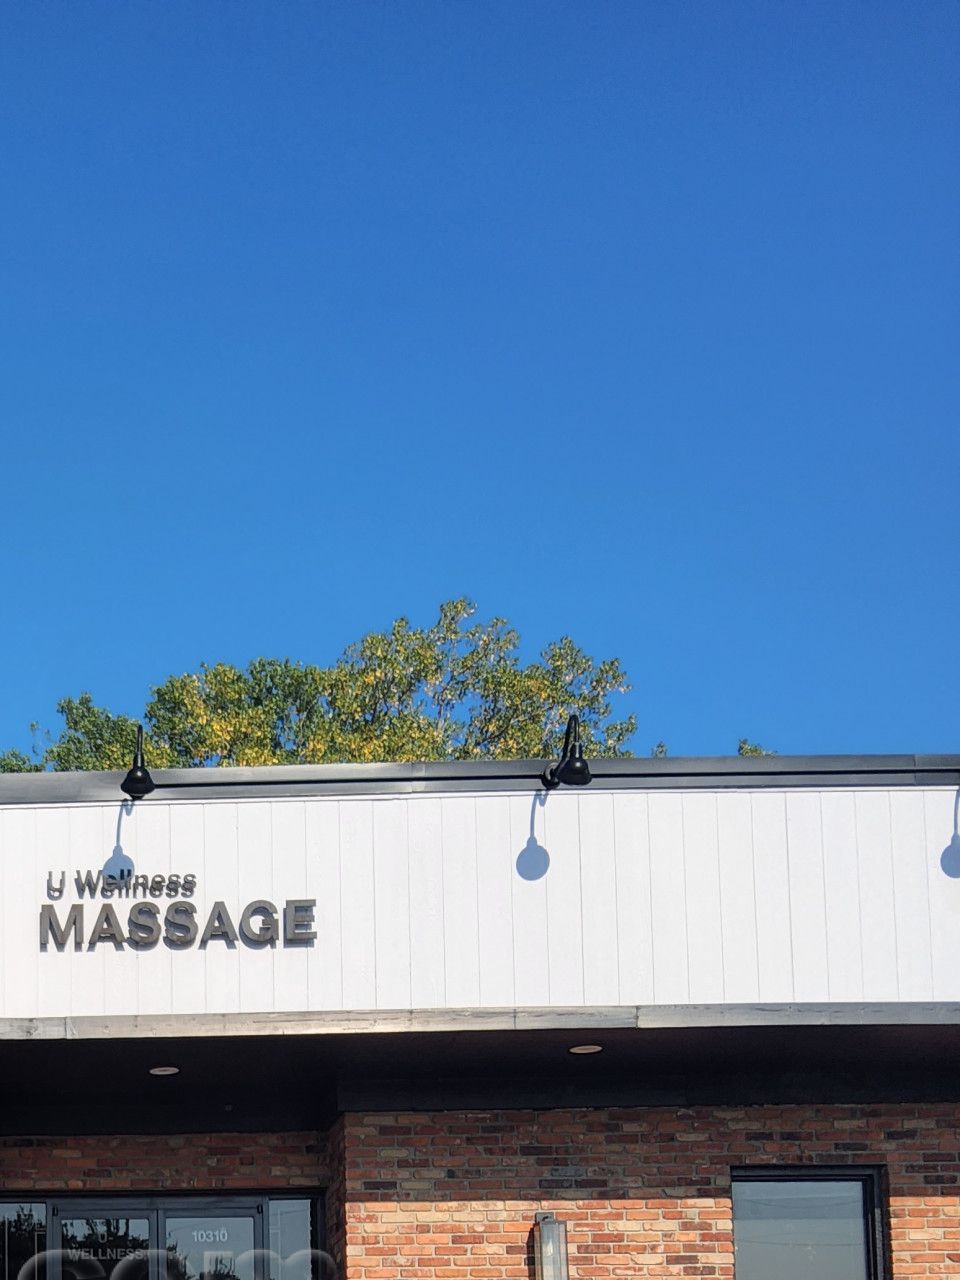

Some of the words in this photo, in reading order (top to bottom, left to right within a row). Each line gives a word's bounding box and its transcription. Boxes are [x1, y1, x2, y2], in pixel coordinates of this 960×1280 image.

[47, 870, 66, 896] U
[76, 868, 197, 895] Wellness
[40, 899, 318, 947] MASSAGE
[191, 1229, 228, 1242] 10310
[67, 1248, 145, 1261] WELLNESS
